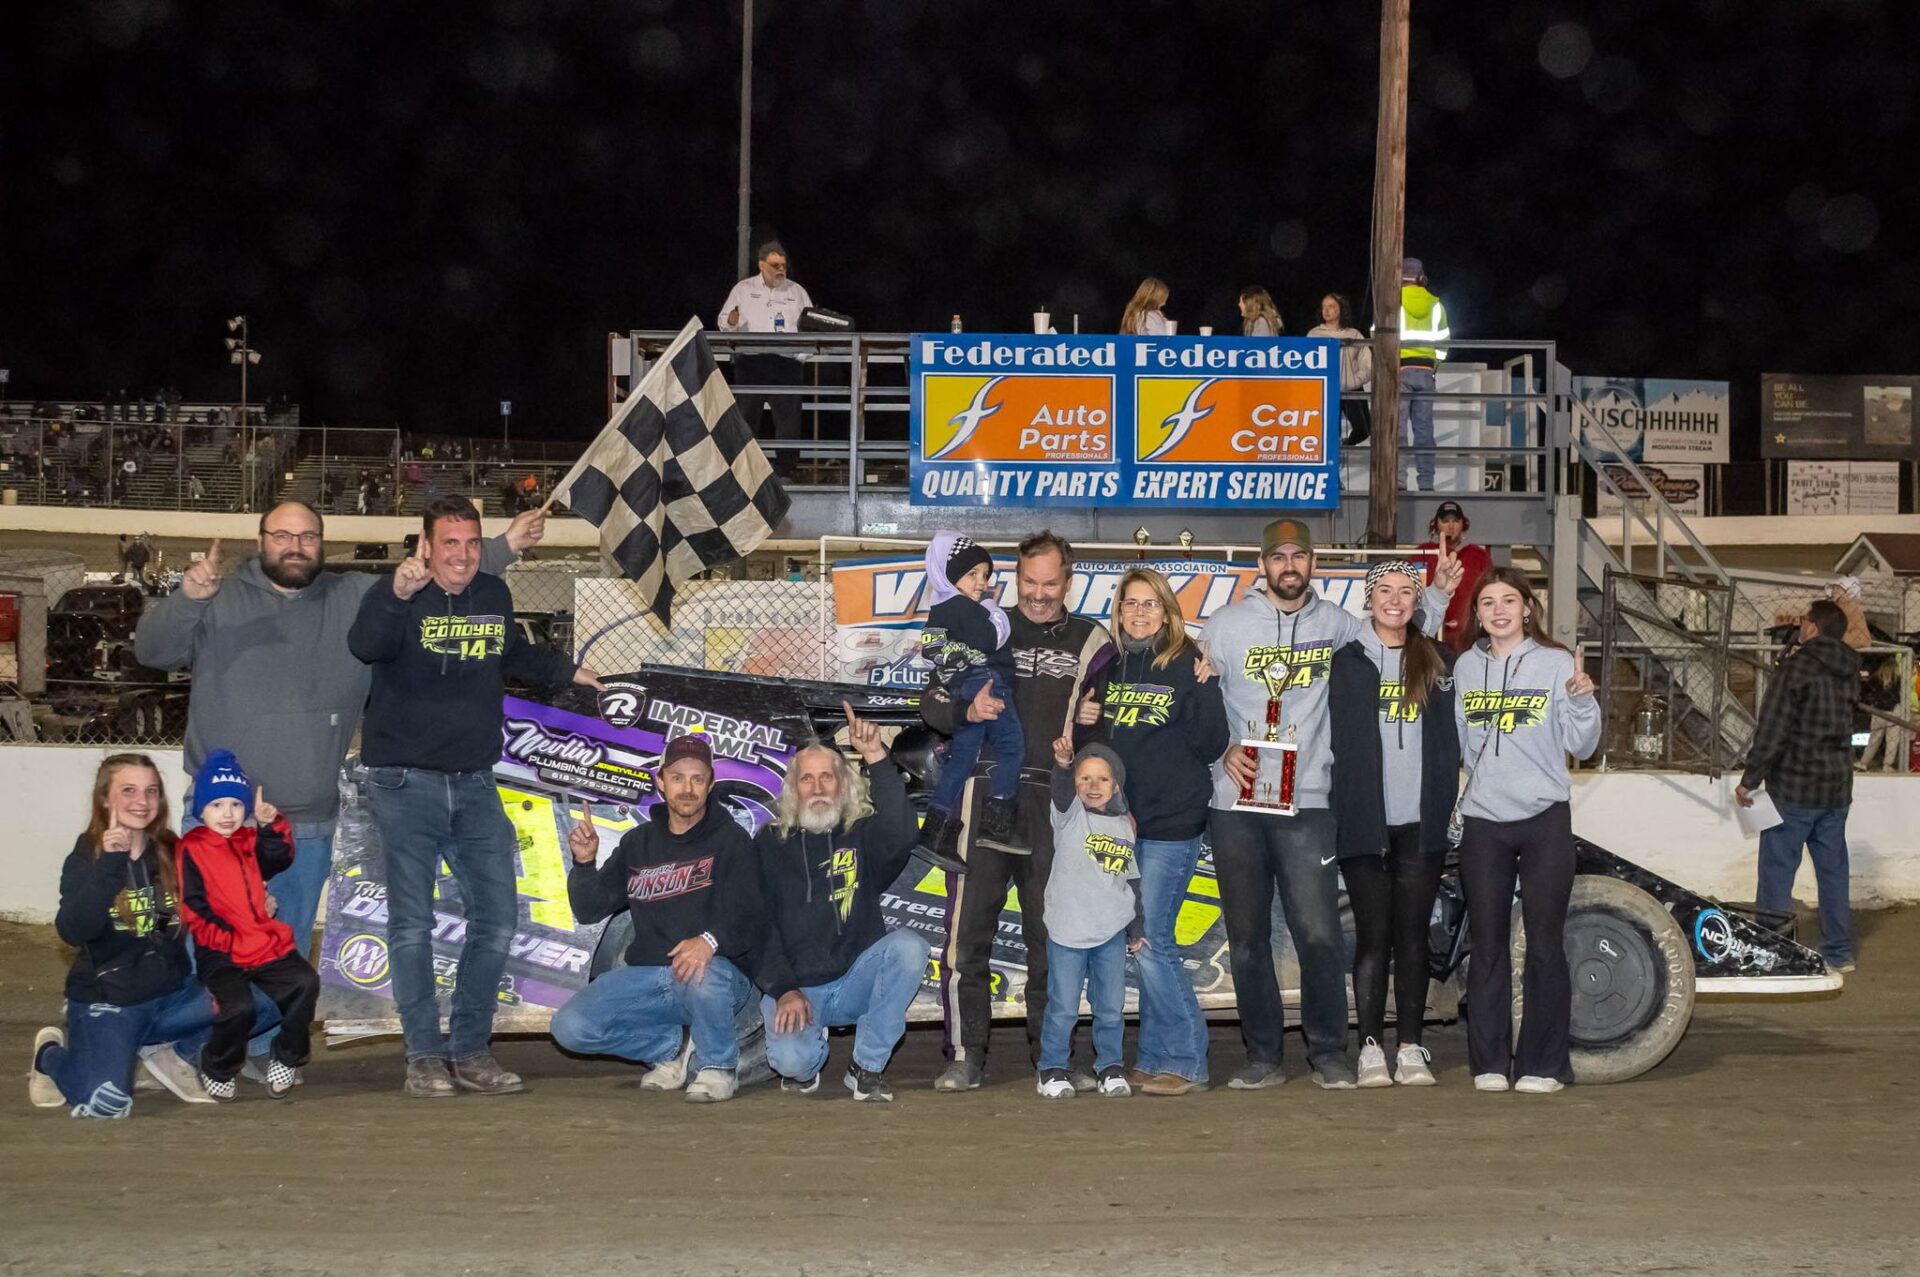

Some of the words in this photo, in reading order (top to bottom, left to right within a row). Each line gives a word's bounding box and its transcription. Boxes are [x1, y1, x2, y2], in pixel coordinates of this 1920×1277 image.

[922, 341, 1116, 366] Federated
[1135, 342, 1328, 369] Federated
[1030, 404, 1107, 426] Auto
[1251, 404, 1320, 427] Car
[1018, 428, 1107, 451] Parts
[1231, 430, 1319, 452] Care
[921, 470, 1031, 498] QUALITY
[1034, 471, 1119, 497] PARTS
[1133, 471, 1229, 499] EXPERT
[1227, 472, 1328, 500] SERVICE
[1075, 562, 1105, 570] AUTO
[1154, 563, 1227, 573] ASSOCIATION
[460, 639, 487, 660] 14
[507, 719, 602, 767] Newlin
[528, 755, 588, 777] PLUMBING
[588, 769, 595, 777] &
[596, 772, 653, 792] ELECTRIC
[880, 893, 946, 919] Tree
